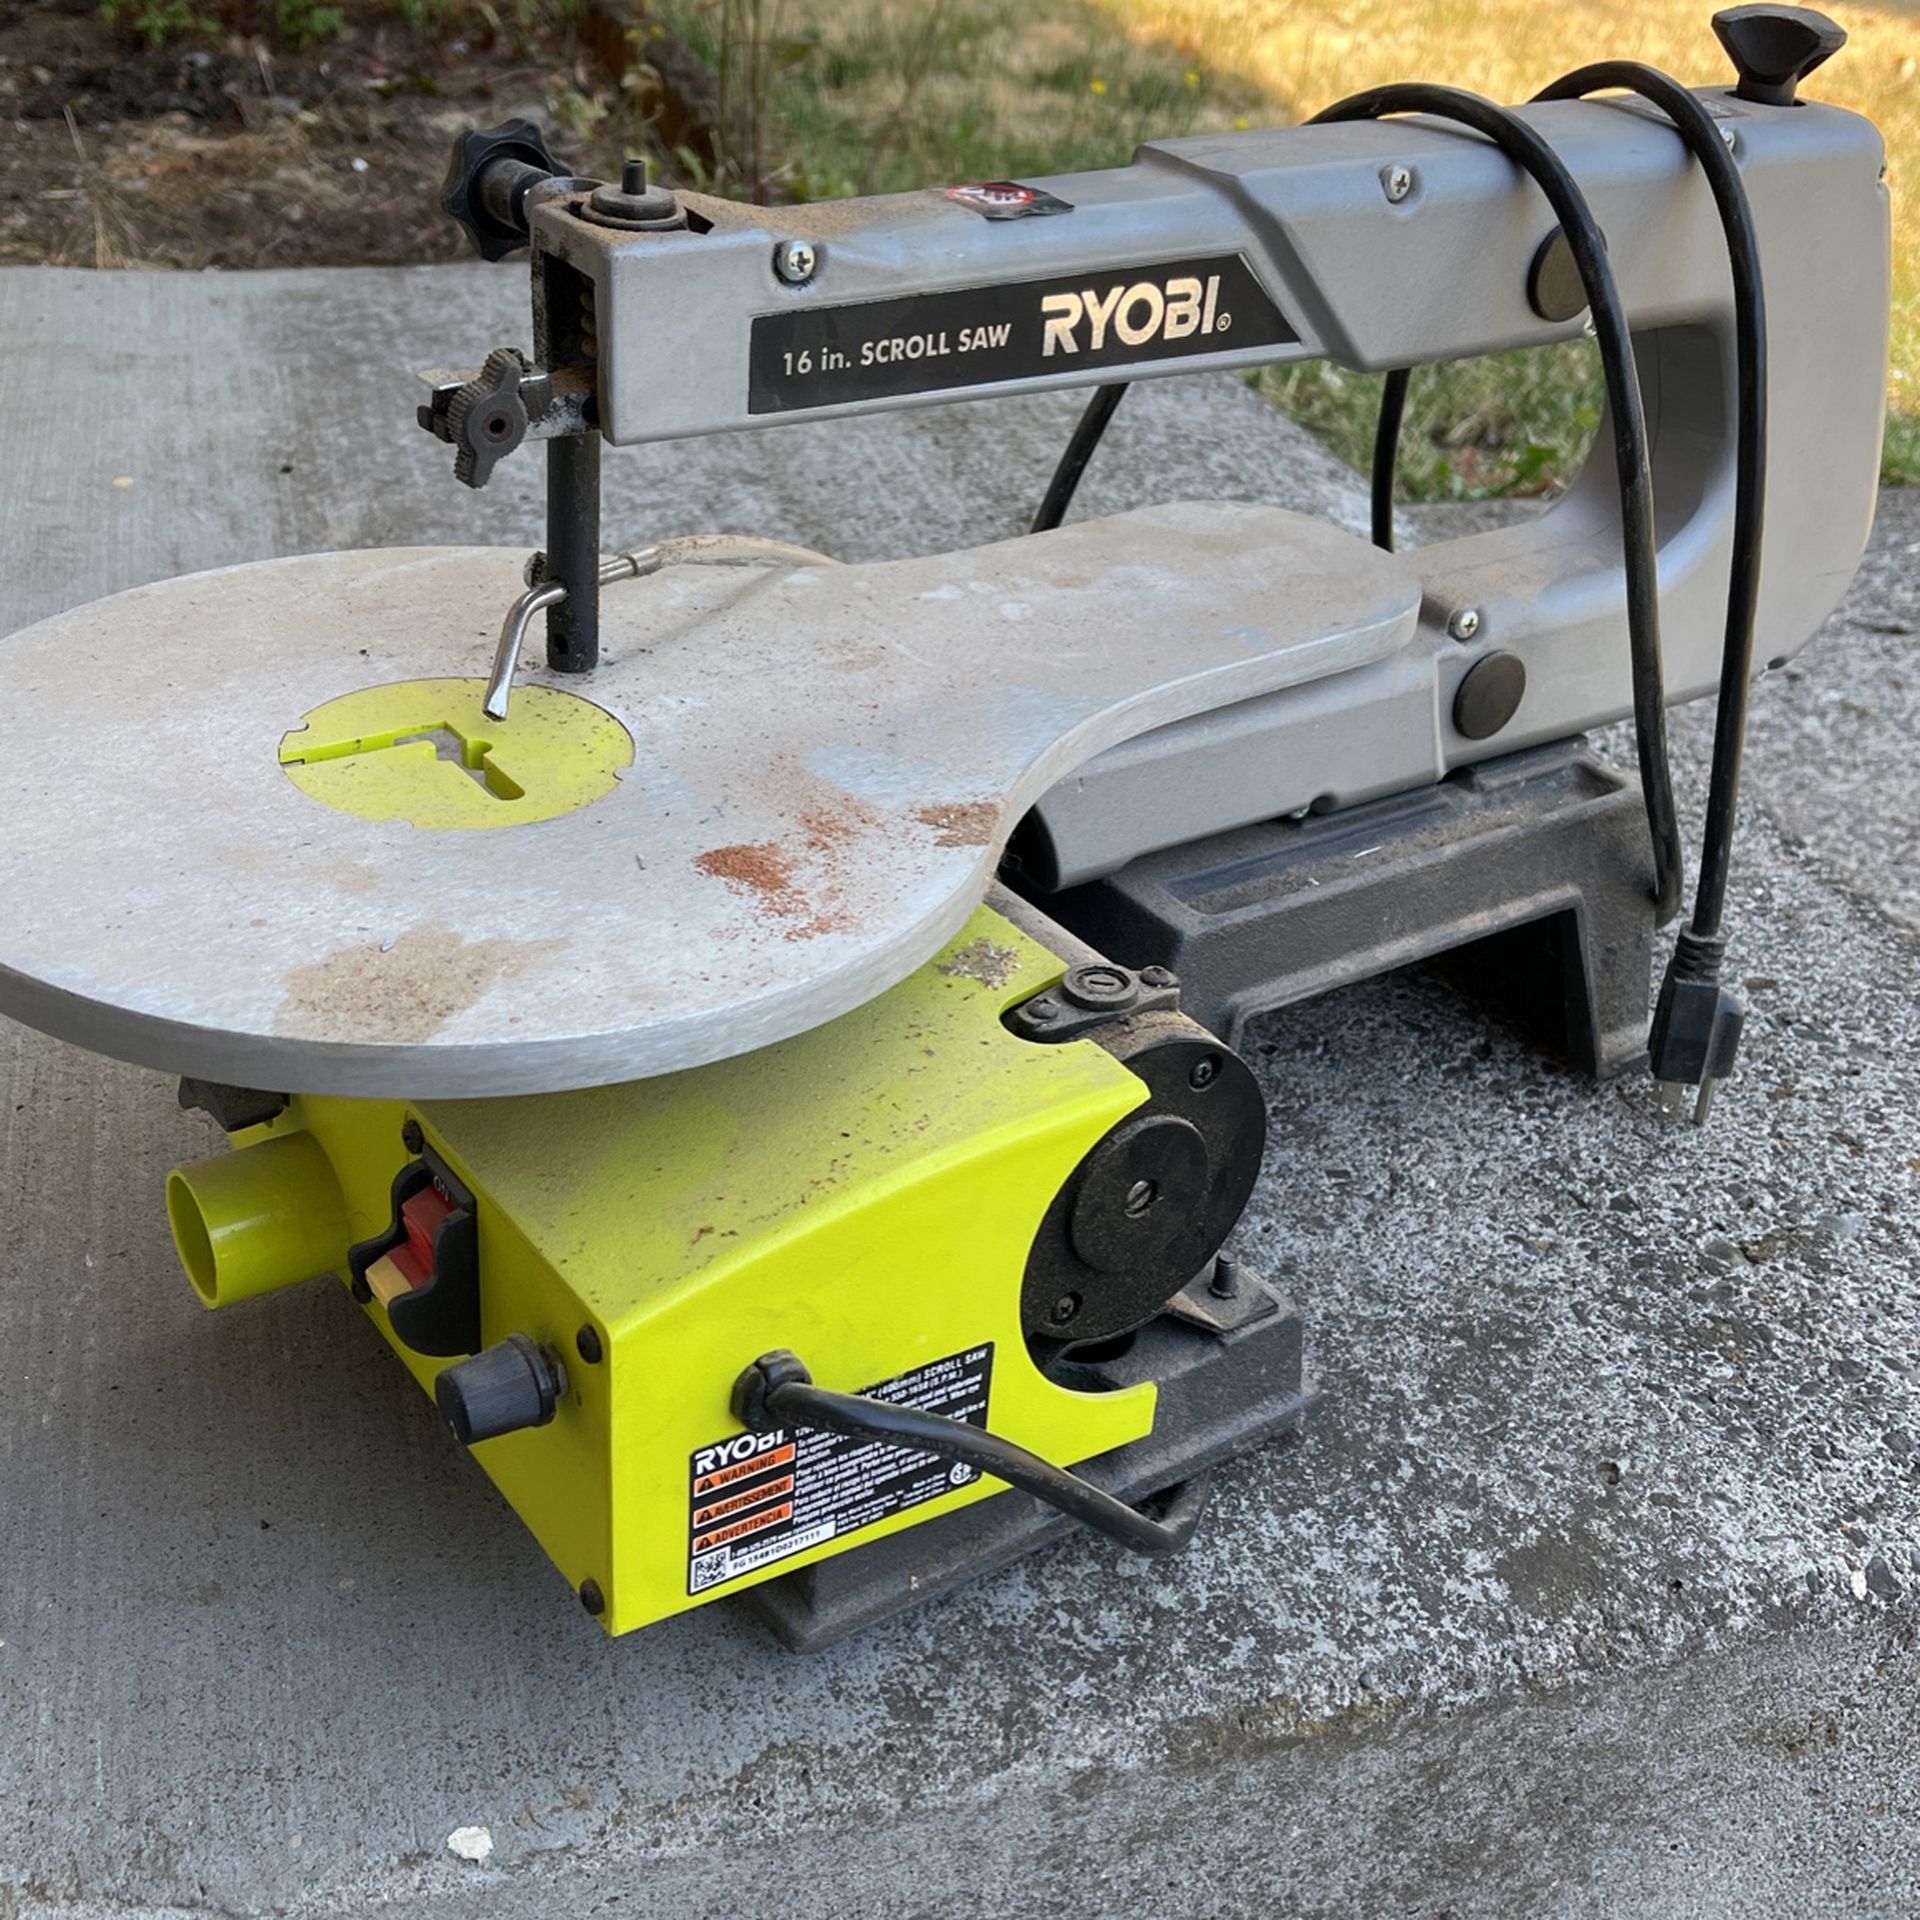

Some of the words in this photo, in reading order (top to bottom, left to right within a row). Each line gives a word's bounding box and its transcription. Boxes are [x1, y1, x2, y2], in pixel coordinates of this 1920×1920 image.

[784, 350, 812, 375] 16
[821, 347, 851, 370] in.
[860, 332, 950, 366] SCROLL
[958, 323, 1012, 351] SAW
[924, 1359, 961, 1379] SCROLL
[965, 1348, 987, 1364] SAW
[719, 1454, 776, 1483] WARNING
[715, 1481, 788, 1516] AVERTISSEMENT
[715, 1509, 782, 1542] ADVERTENCIA
